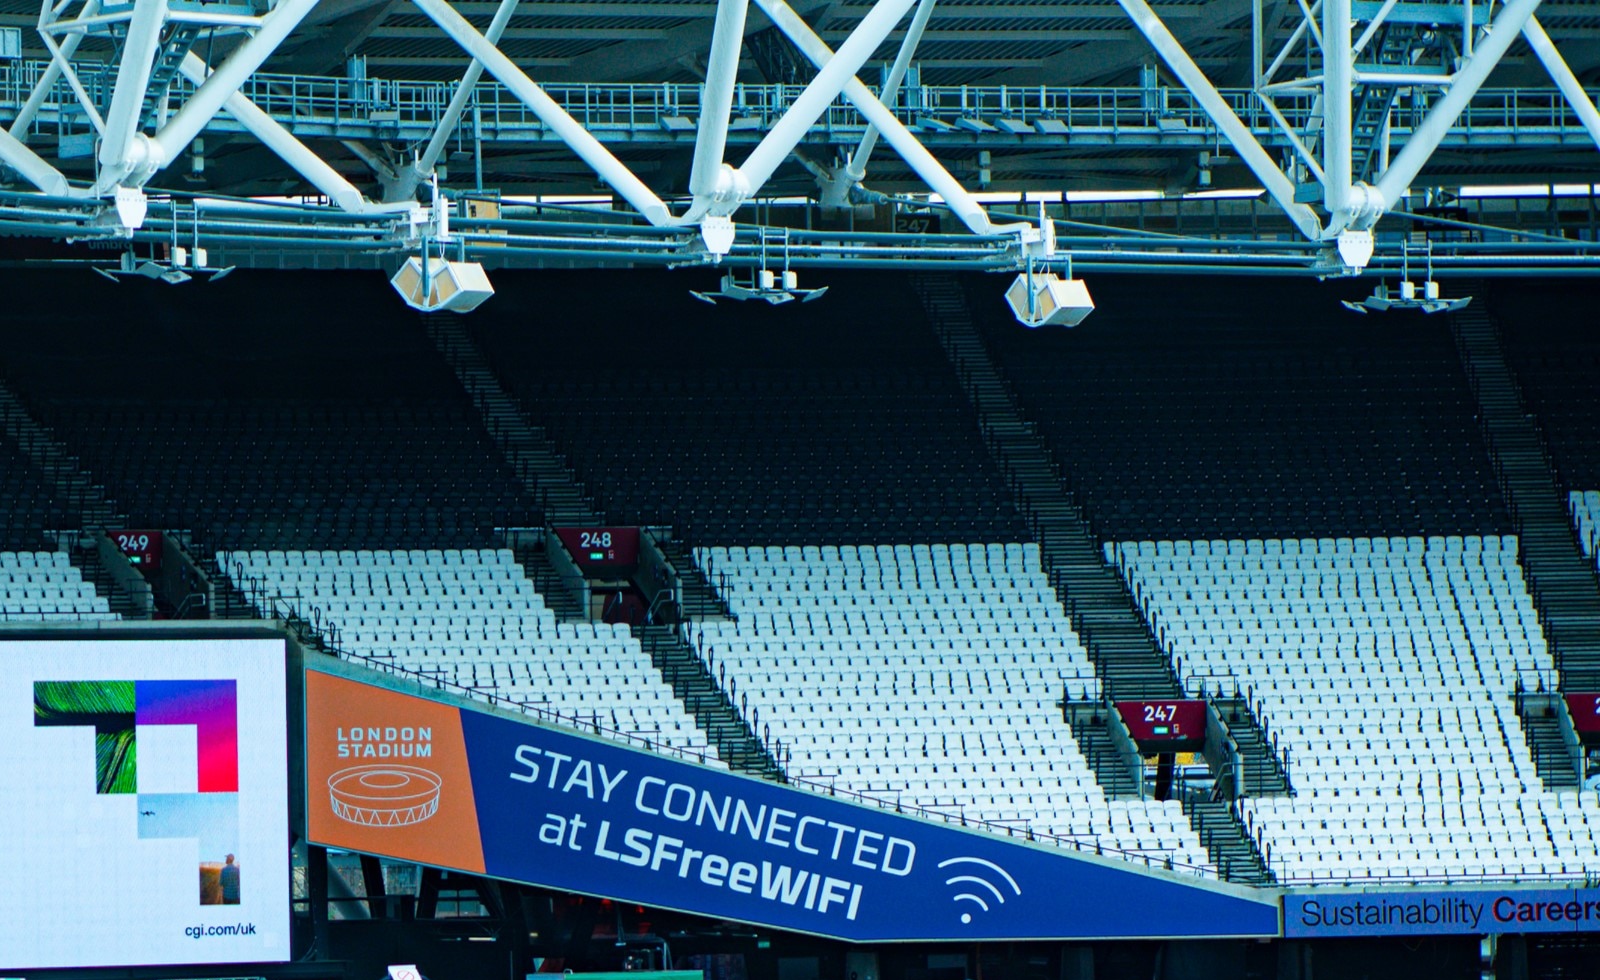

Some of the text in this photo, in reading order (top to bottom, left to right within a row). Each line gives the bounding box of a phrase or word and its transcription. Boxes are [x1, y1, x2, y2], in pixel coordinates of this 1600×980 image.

[118, 534, 150, 551] 249
[580, 531, 612, 548] 248
[1144, 704, 1178, 722] 247
[337, 727, 432, 742] LONDON
[337, 743, 432, 758] STADIUM
[510, 744, 917, 878] STAY CONNECTED
[538, 811, 863, 922] at LSFreeWIFI
[1301, 897, 1484, 929] Sustainability
[185, 923, 257, 939] cgi.com/uk
